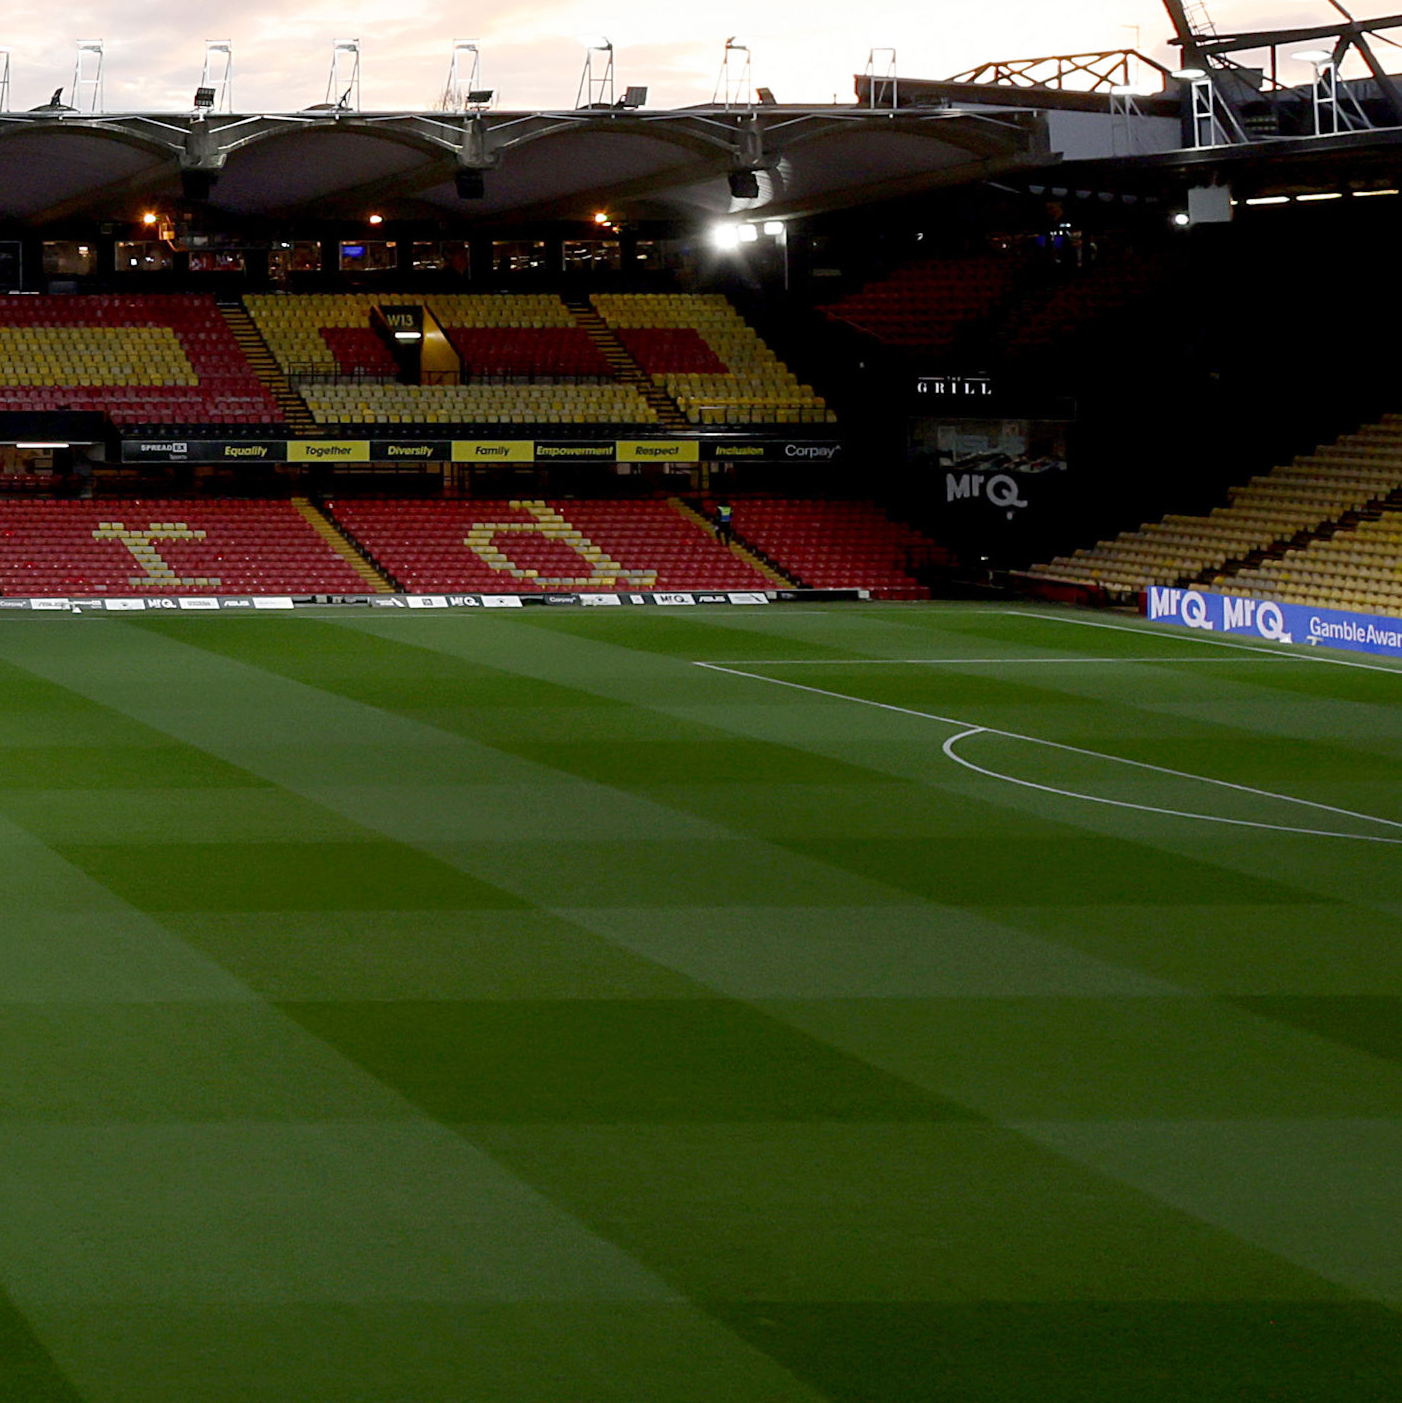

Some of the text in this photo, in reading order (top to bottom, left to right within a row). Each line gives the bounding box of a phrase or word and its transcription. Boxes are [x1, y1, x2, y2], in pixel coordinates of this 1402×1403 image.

[386, 313, 414, 327] W13
[917, 382, 993, 395] GRILL
[223, 445, 269, 458] Equality
[305, 445, 353, 458] Together
[387, 445, 435, 458] Diversity
[475, 445, 510, 458] Family
[535, 445, 614, 458] Empowerment
[635, 445, 680, 457] Respect
[714, 445, 765, 456] Inclusion
[784, 443, 836, 459] Corpay
[945, 473, 1029, 509] MrQ
[1150, 586, 1293, 643] MrQ MrQ
